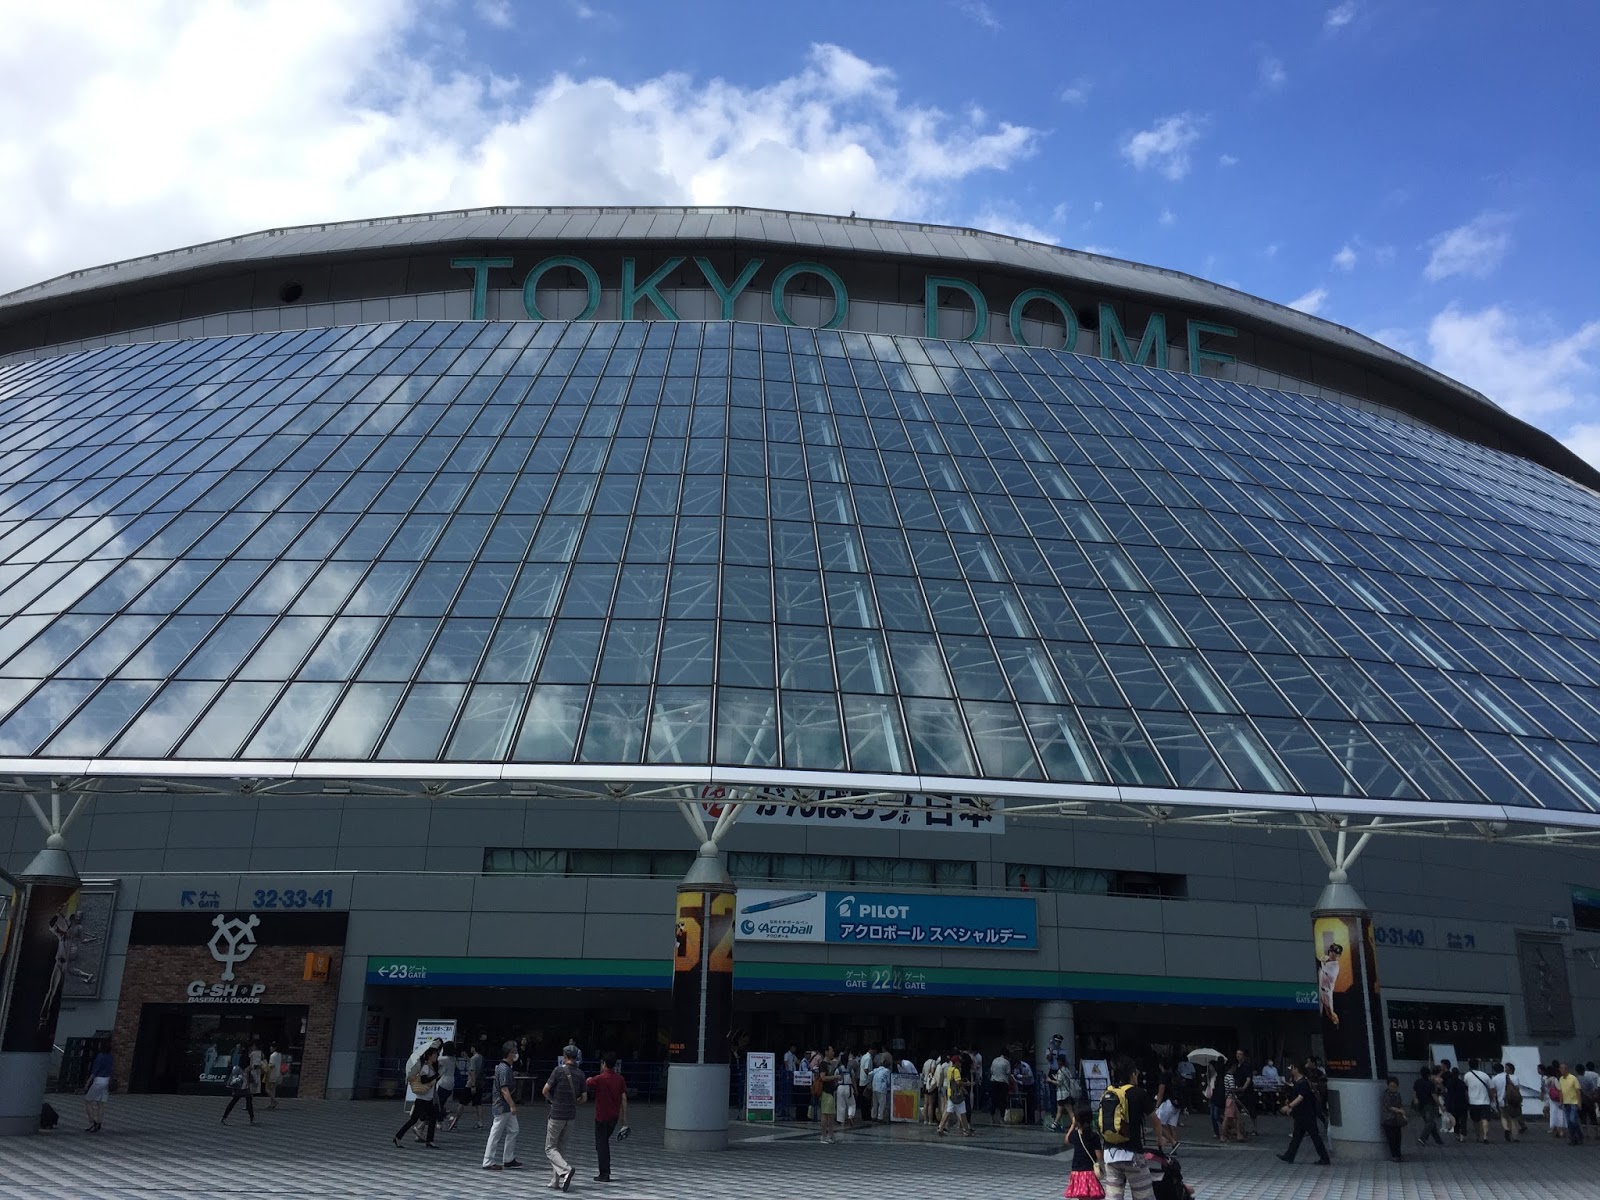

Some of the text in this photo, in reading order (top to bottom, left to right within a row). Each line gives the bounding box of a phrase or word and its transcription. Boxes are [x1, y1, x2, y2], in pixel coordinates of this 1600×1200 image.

[450, 255, 848, 329] TOKYO
[859, 905, 909, 919] PILOT
[758, 922, 813, 935] Acroball
[840, 924, 1027, 944] アクロボール スペシャルデー
[389, 964, 408, 979] 23
[846, 970, 867, 979] ゲート
[905, 972, 926, 981] ゲート
[845, 980, 867, 988] GATE
[871, 970, 891, 990] 22
[904, 982, 926, 990] GATE
[1311, 991, 1319, 1004] 2
